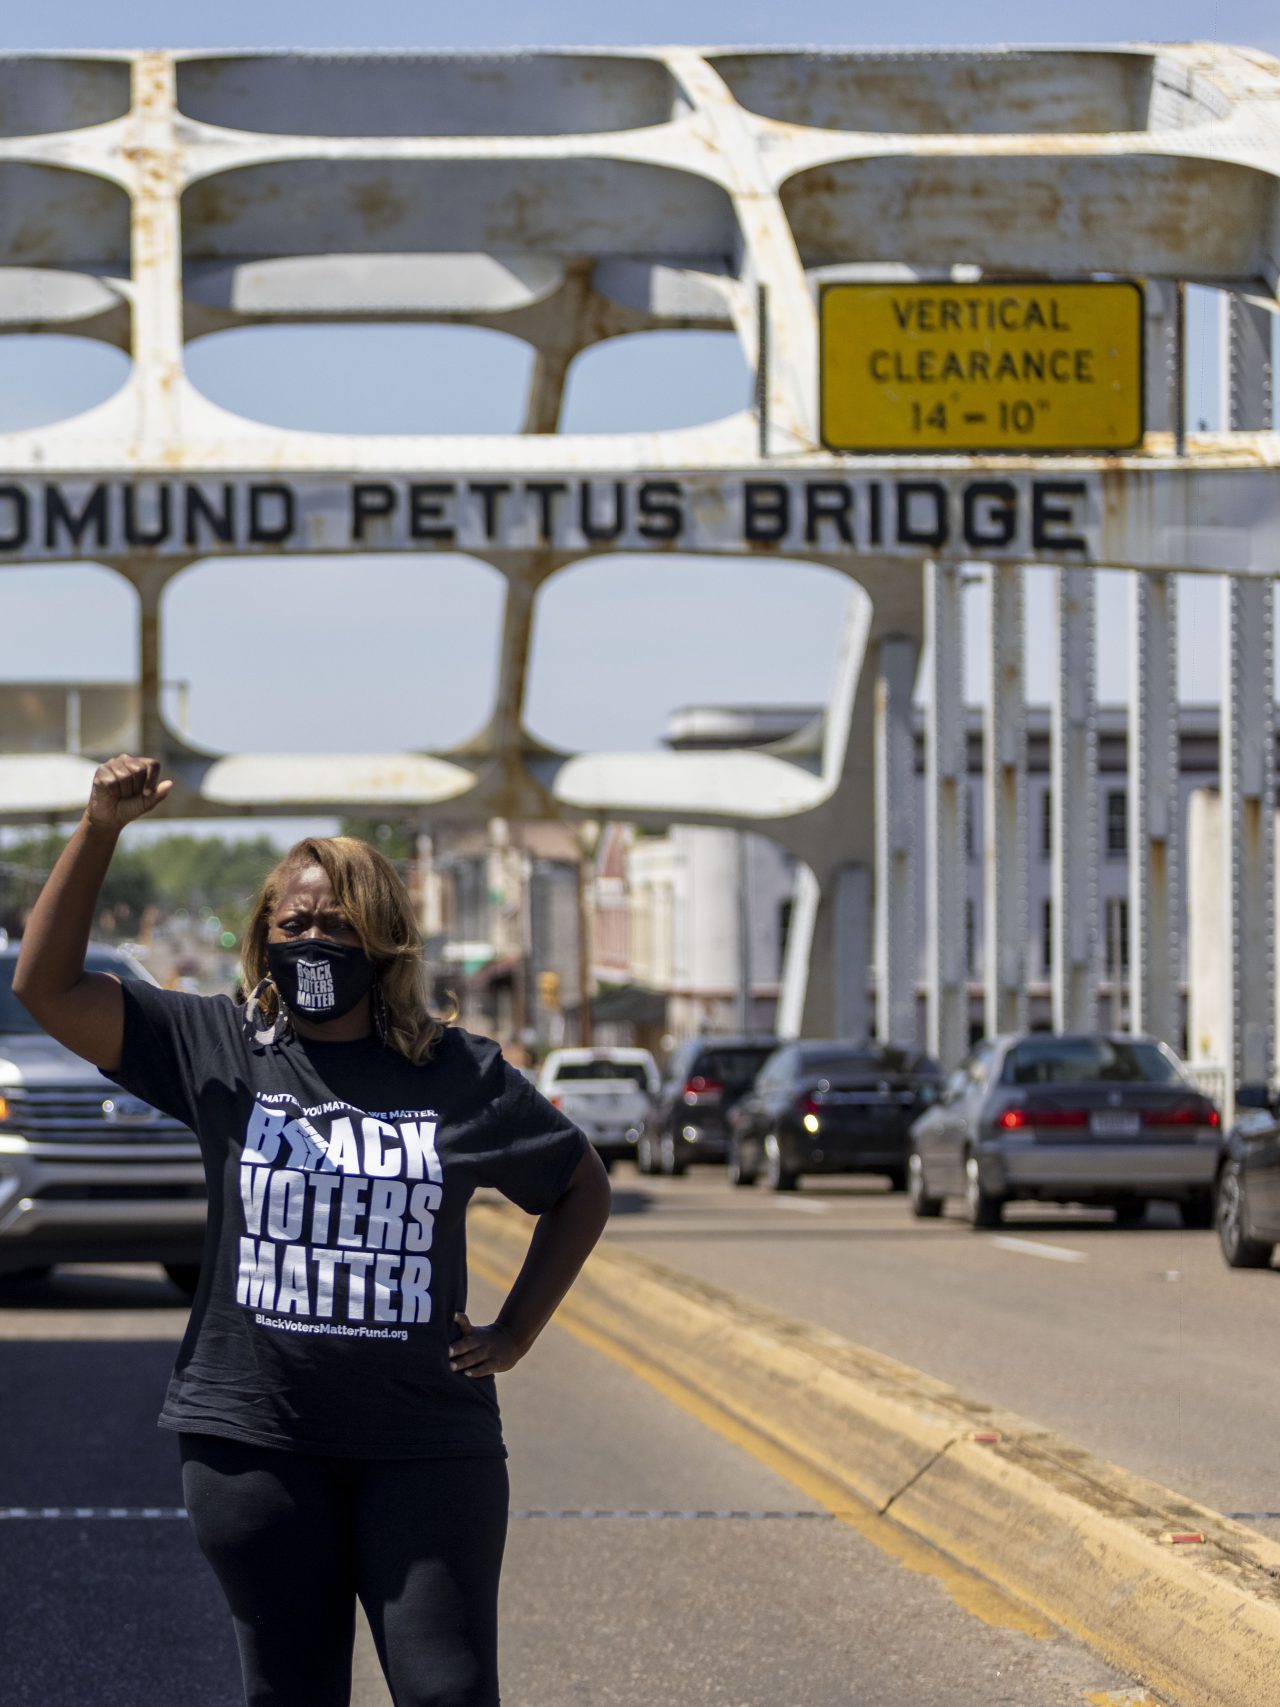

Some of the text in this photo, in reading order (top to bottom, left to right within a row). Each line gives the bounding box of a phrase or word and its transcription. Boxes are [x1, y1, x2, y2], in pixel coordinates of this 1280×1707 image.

[893, 298, 1071, 331] VERTICAL
[870, 351, 1094, 383] CLEARANCE
[350, 481, 684, 542] PETTUS
[743, 479, 1090, 550] BRIDGE
[297, 963, 332, 981] BACK
[298, 977, 334, 993] VOTERS
[297, 991, 335, 1007] MATTER
[302, 1105, 322, 1117] YOU
[322, 1101, 368, 1116] MATT
[368, 1111, 388, 1119] WE
[389, 1109, 438, 1119] MATTER.
[240, 1101, 443, 1183] BACK
[240, 1165, 442, 1252] VOTERS
[237, 1236, 432, 1323] MATTER
[255, 1314, 408, 1341] BlackVotersMatterFund.org
